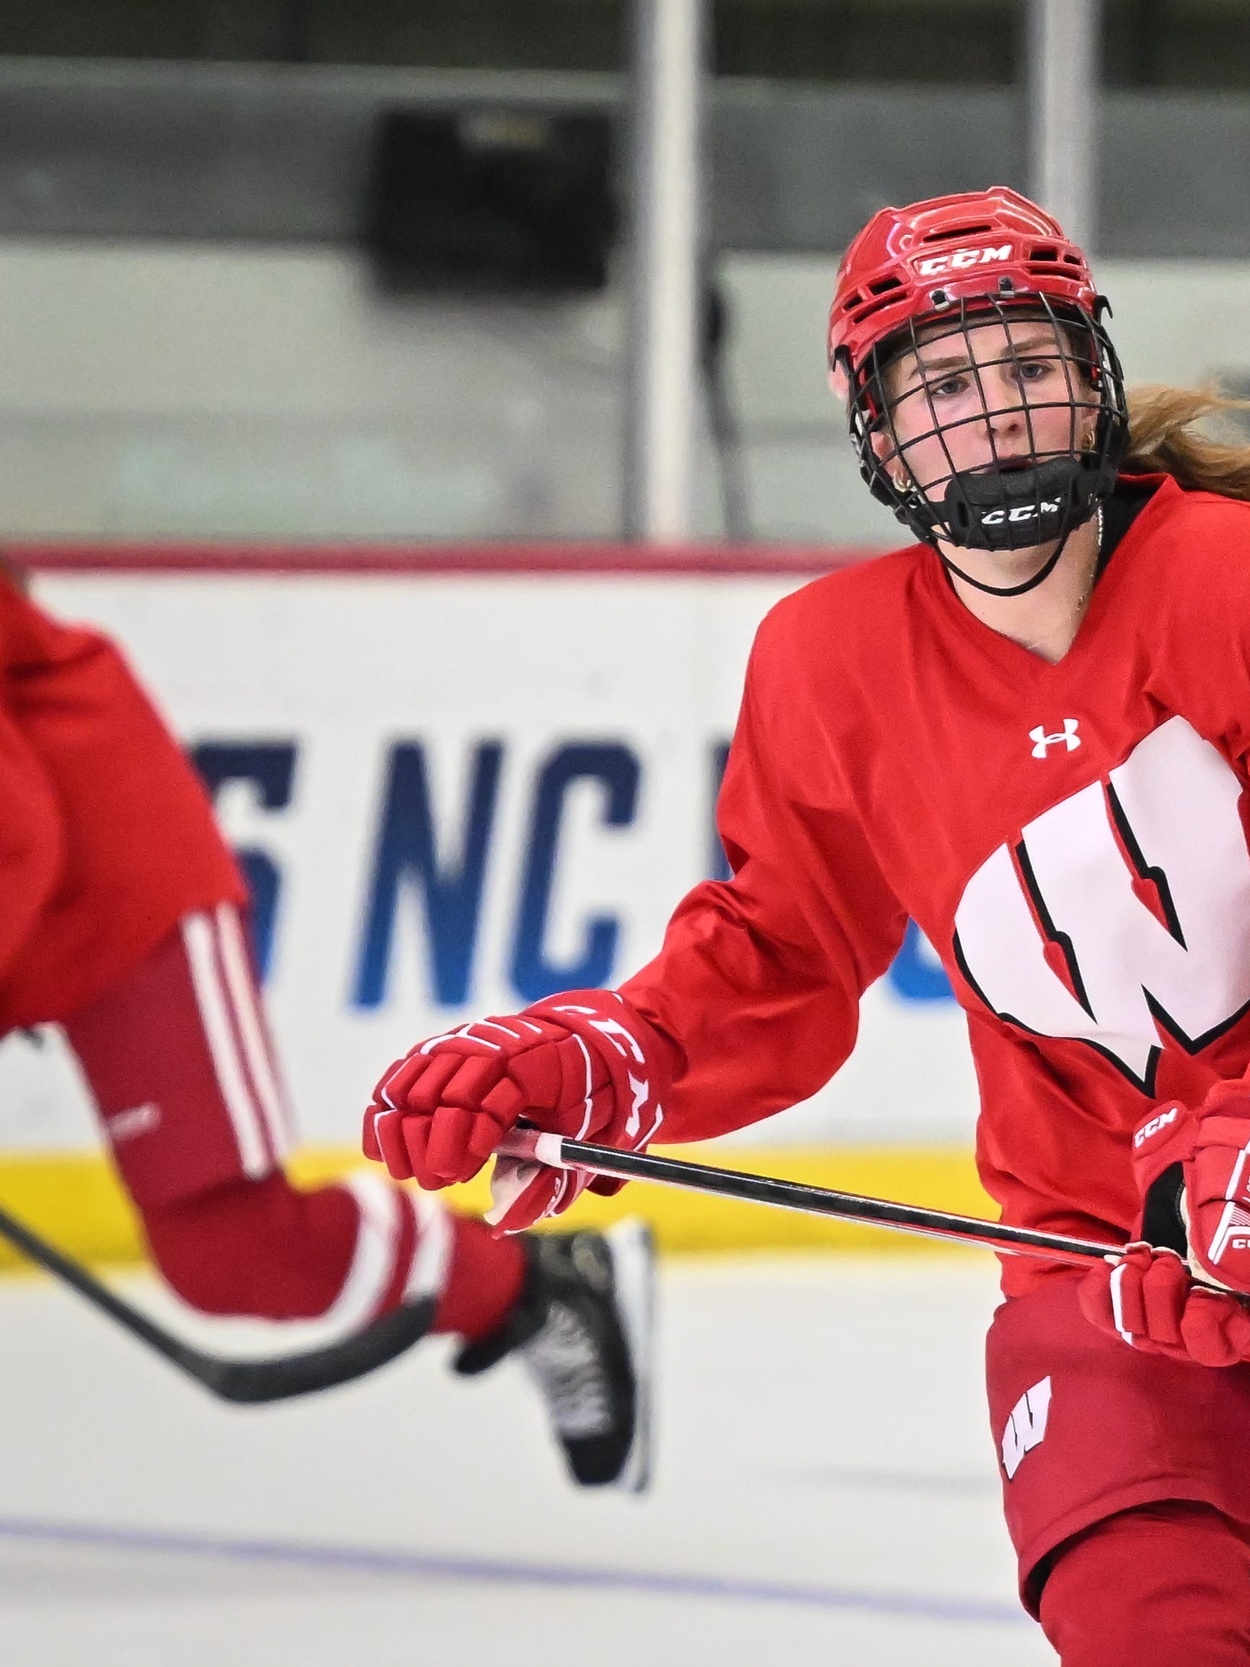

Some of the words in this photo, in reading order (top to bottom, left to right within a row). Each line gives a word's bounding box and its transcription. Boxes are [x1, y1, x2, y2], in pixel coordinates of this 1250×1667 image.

[919, 244, 1013, 276] CCM
[981, 496, 1062, 525] CCM
[1134, 1107, 1179, 1149] CCM
